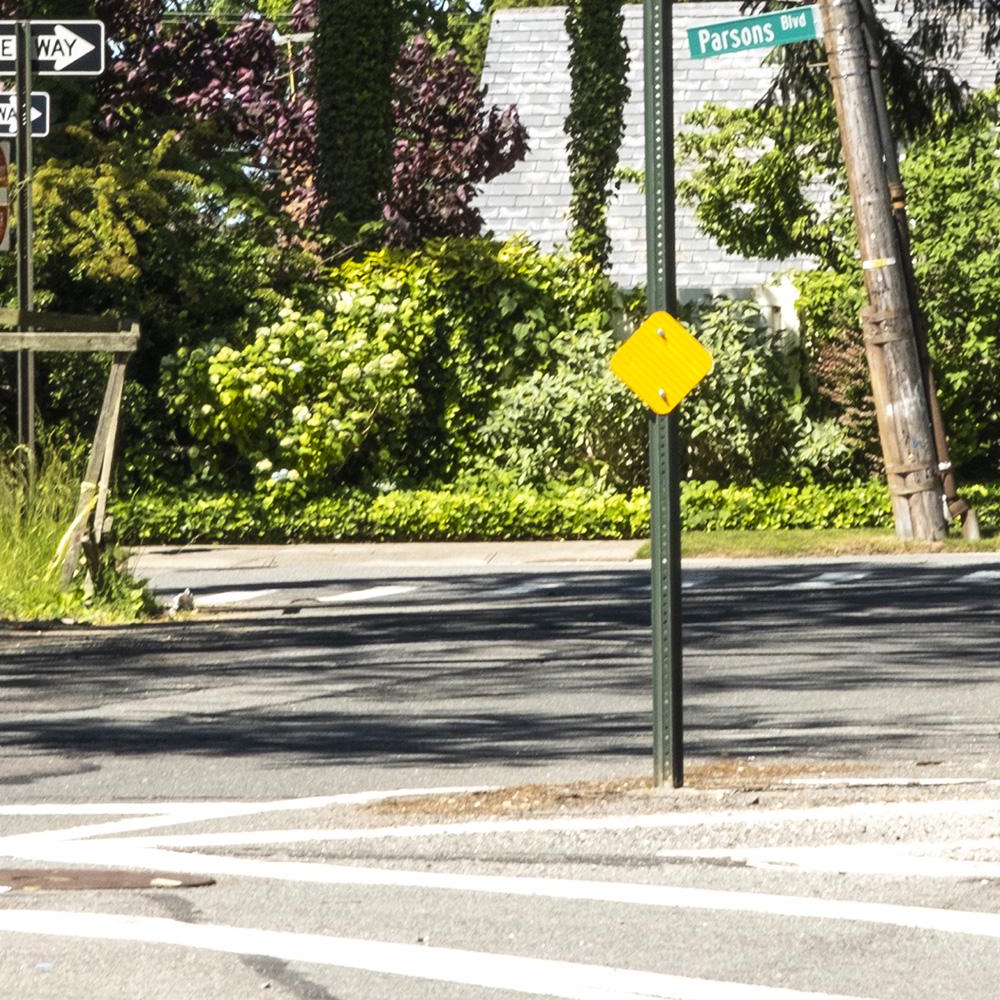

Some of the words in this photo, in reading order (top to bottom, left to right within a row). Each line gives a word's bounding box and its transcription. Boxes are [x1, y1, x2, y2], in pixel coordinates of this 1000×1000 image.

[36, 39, 77, 57] WAY
[698, 22, 775, 54] Parsons
[780, 12, 807, 31] Blvd
